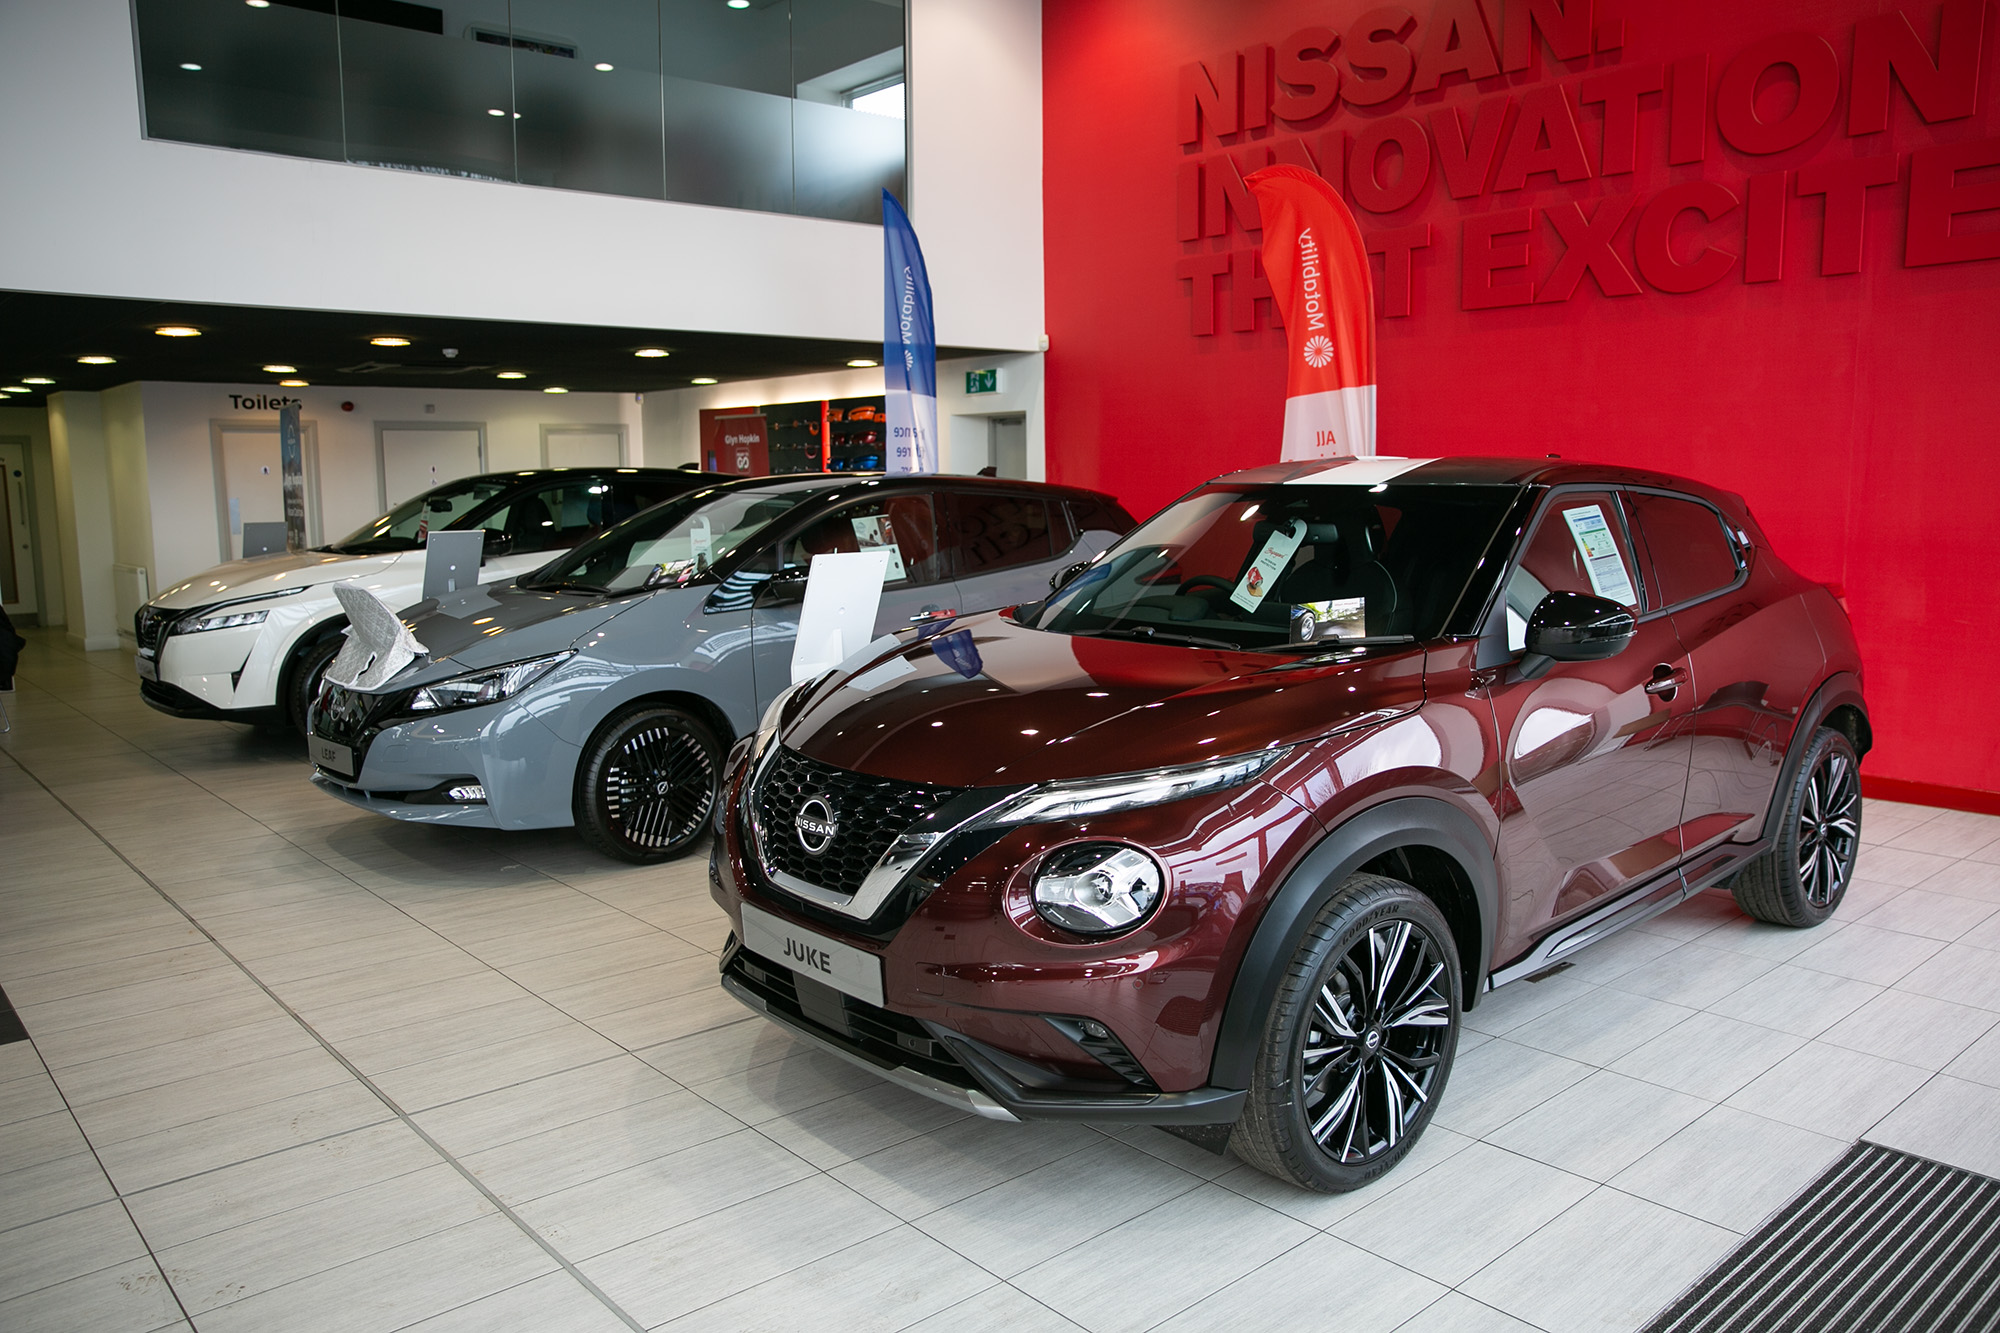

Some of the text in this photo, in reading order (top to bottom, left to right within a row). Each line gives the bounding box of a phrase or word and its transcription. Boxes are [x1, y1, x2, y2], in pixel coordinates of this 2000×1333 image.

[1178, 140, 2000, 337] THT EXCITE
[725, 434, 760, 446] Glyn Hopkin
[321, 746, 336, 762] LEAF
[795, 817, 835, 836] NISSAN
[783, 937, 832, 974] JUKE
